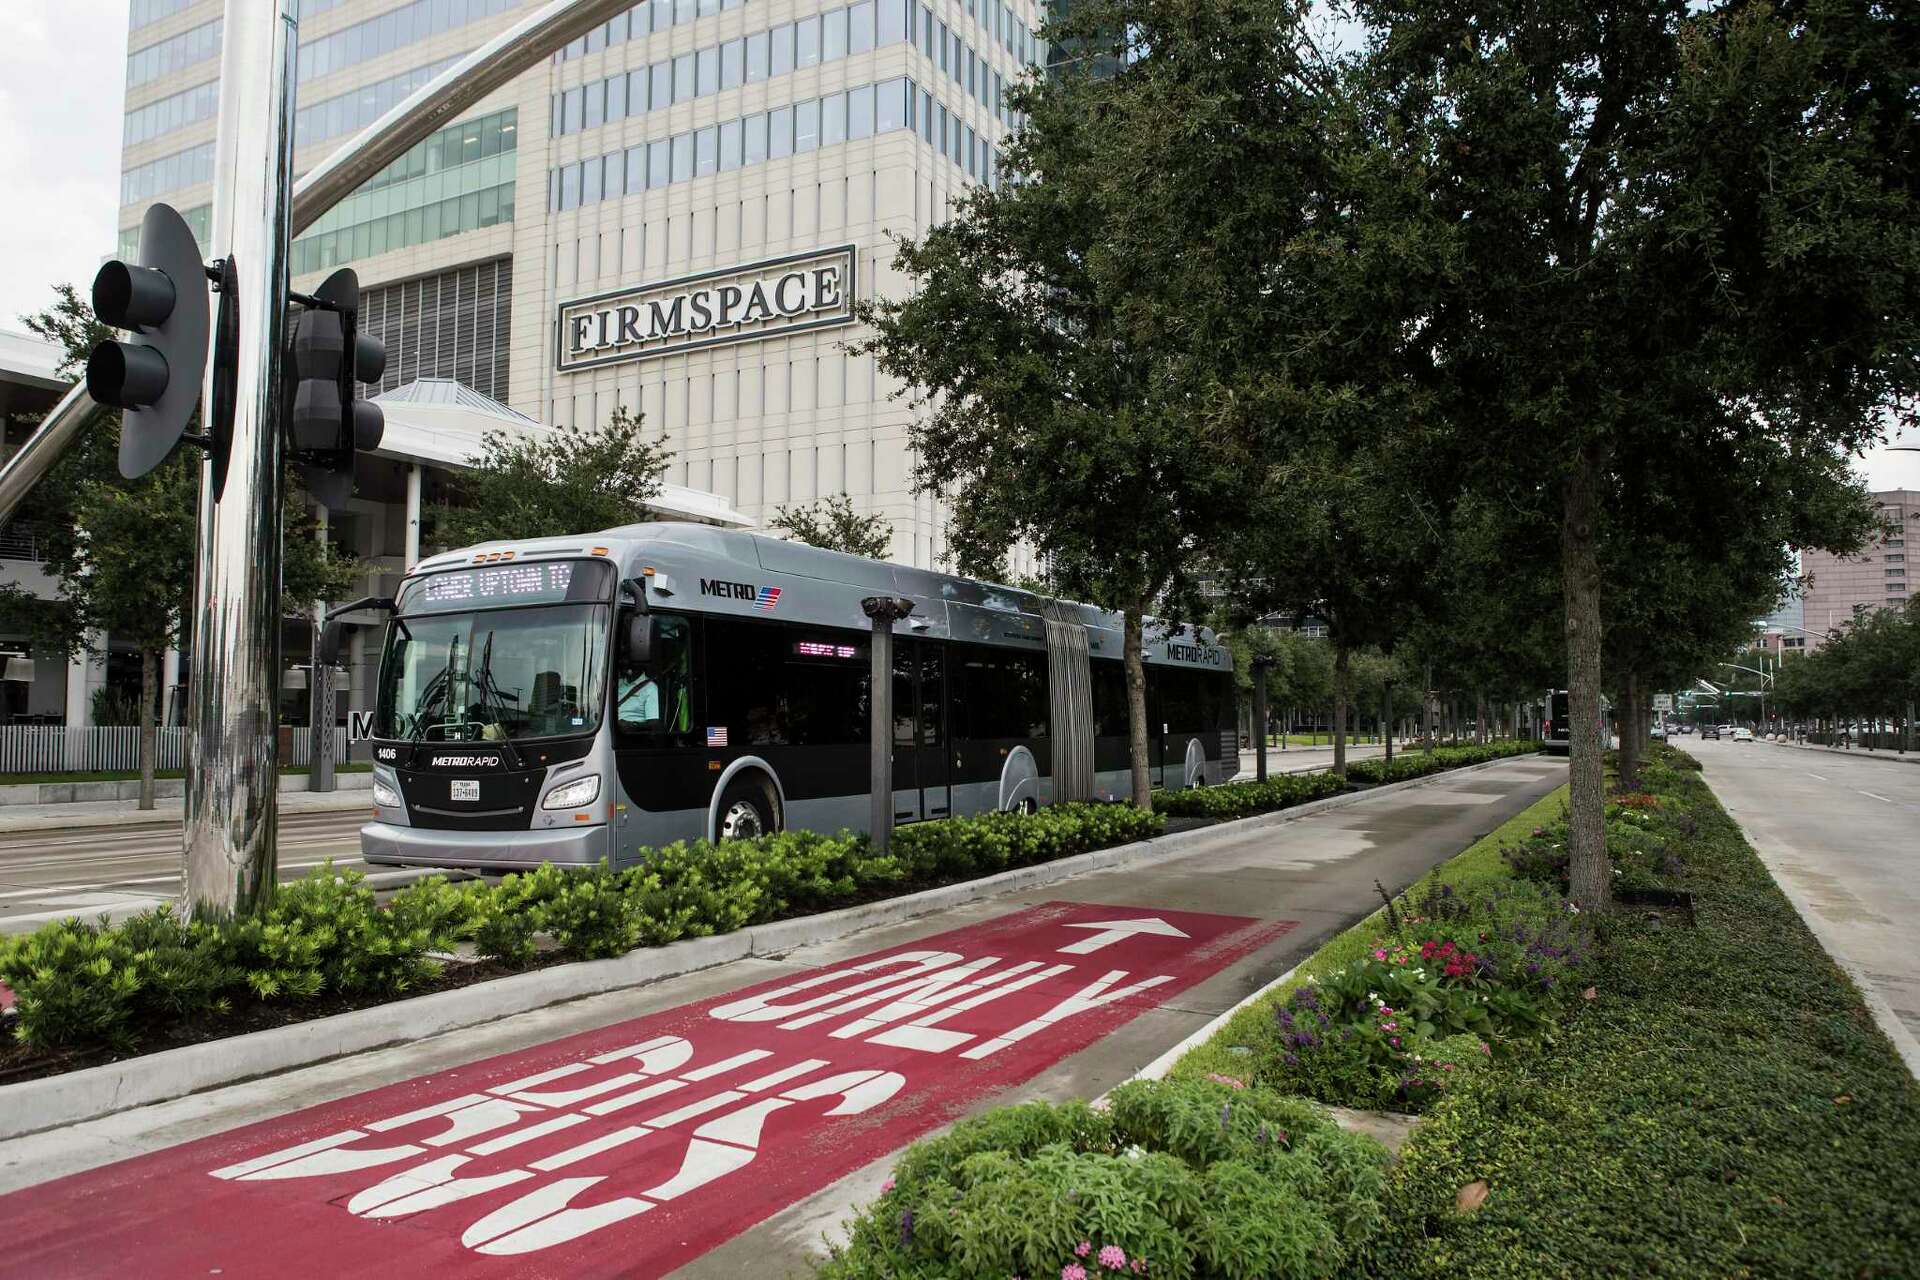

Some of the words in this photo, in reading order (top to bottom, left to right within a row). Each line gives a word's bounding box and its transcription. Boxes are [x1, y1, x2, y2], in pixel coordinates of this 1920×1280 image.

[569, 266, 841, 353] FIRMSPACE
[479, 567, 543, 595] UPTOWN
[699, 578, 757, 601] METRO
[1167, 643, 1221, 666] METRORAPID
[378, 748, 397, 760] 1406
[431, 756, 499, 767] METRORAPID
[708, 950, 1178, 1060] ONLY
[207, 1035, 907, 1256] BUS
